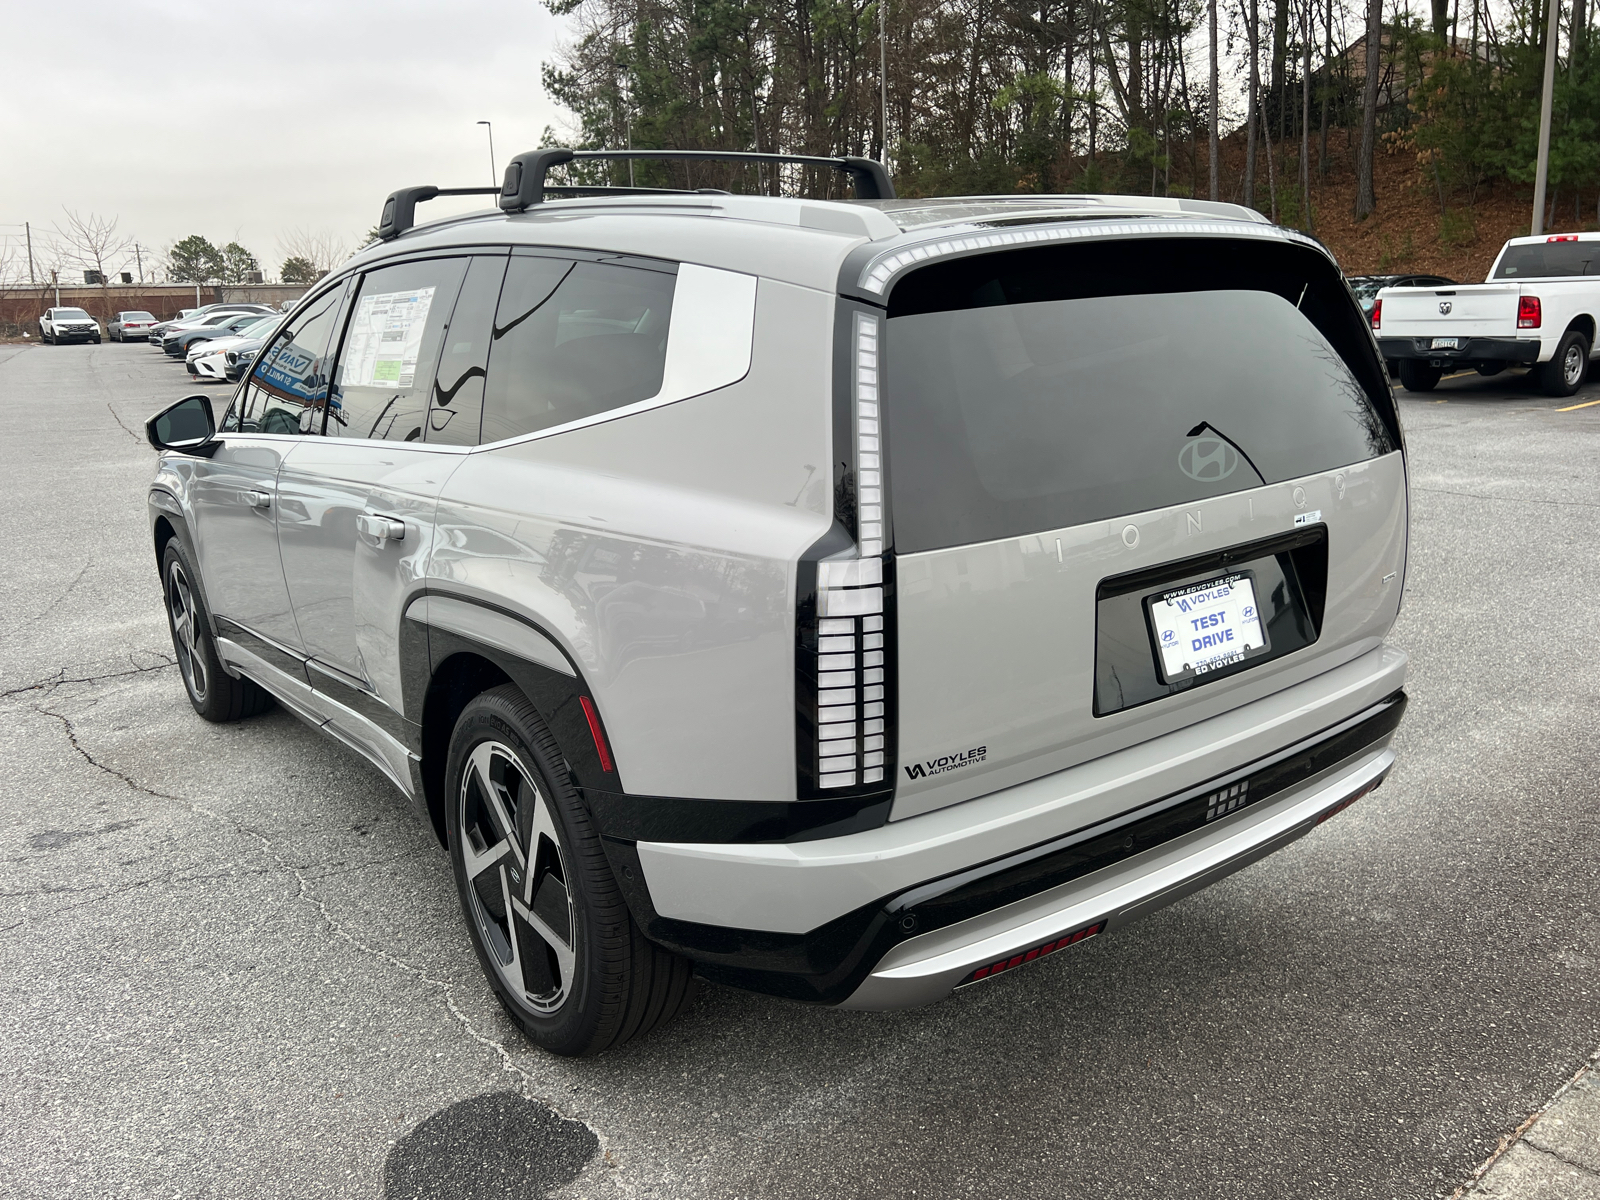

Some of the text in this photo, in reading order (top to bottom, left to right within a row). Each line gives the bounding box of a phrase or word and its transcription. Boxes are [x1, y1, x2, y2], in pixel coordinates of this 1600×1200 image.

[1163, 575, 1241, 600] WWW.EDVOYLES.COM
[1190, 587, 1230, 605] VOYLES
[1191, 611, 1226, 631] TEST
[1192, 628, 1234, 652] DRIVE
[1195, 653, 1245, 675] ED VOYLES
[926, 745, 987, 769] VOYLES
[928, 755, 987, 776] AUTOMOTIVE
